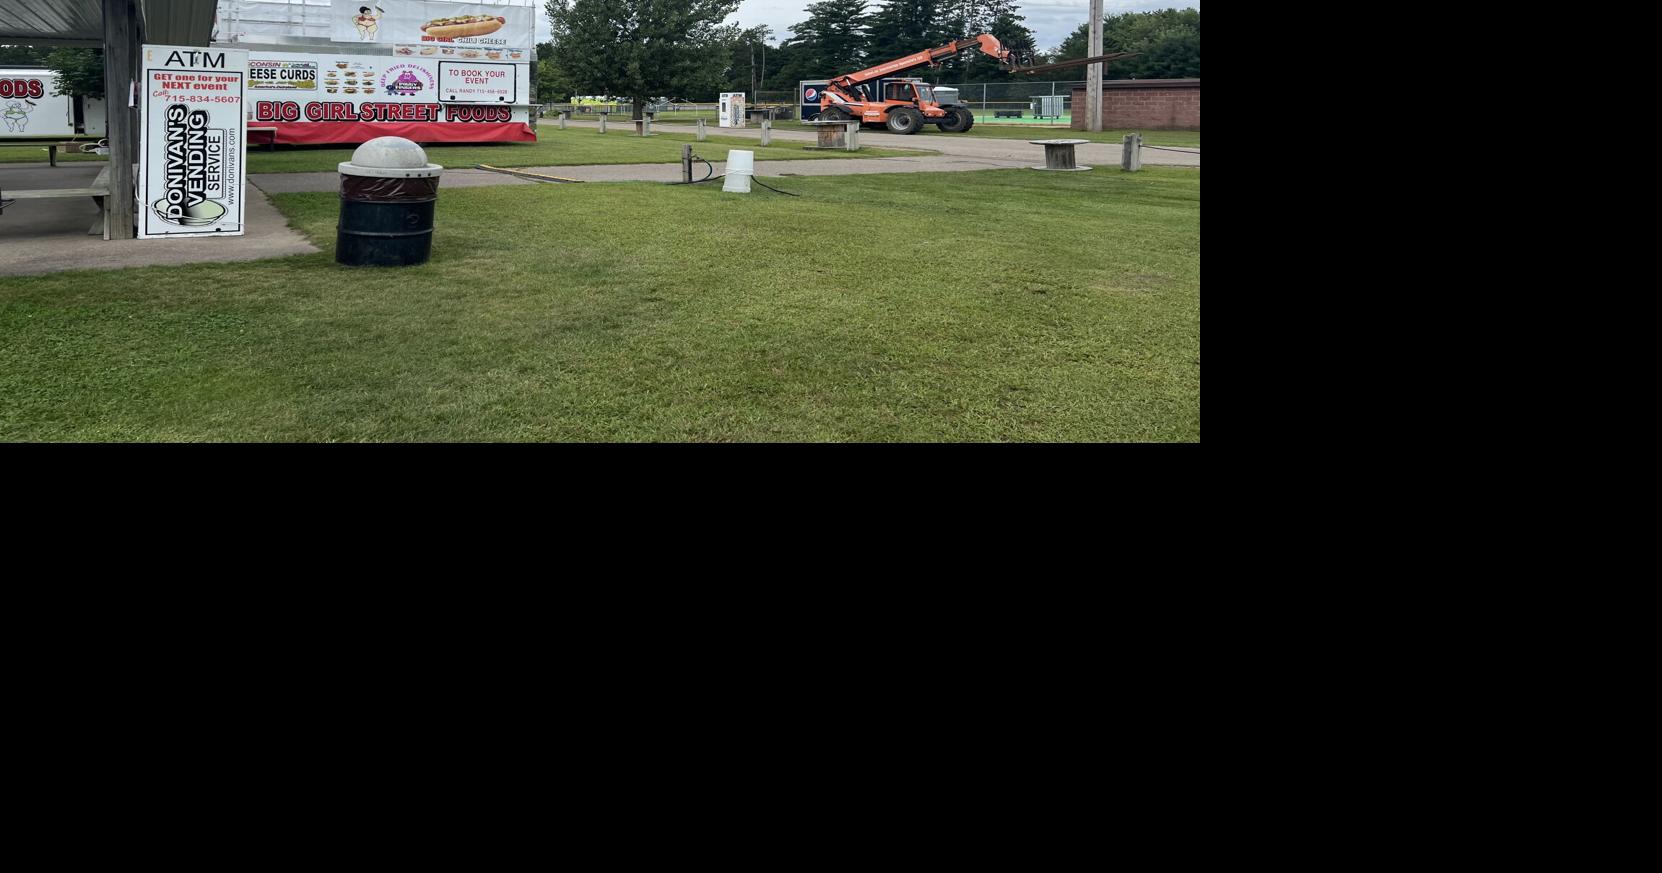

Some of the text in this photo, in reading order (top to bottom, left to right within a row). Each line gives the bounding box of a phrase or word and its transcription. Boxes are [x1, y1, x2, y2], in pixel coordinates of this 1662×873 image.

[164, 50, 225, 68] ATM
[154, 73, 173, 81] GET
[198, 74, 213, 82] for
[250, 68, 315, 80] EESE CURDS
[485, 70, 505, 78] YOUR
[162, 81, 228, 91] NEXT event
[165, 94, 241, 103] 715-834-5607
[256, 101, 513, 122] BIG GIRL STREET FOODS
[166, 105, 187, 220] DONIVAN'S
[186, 111, 207, 208] VENDING
[207, 135, 220, 191] SERVICE
[228, 128, 236, 206] www.donivans.com
